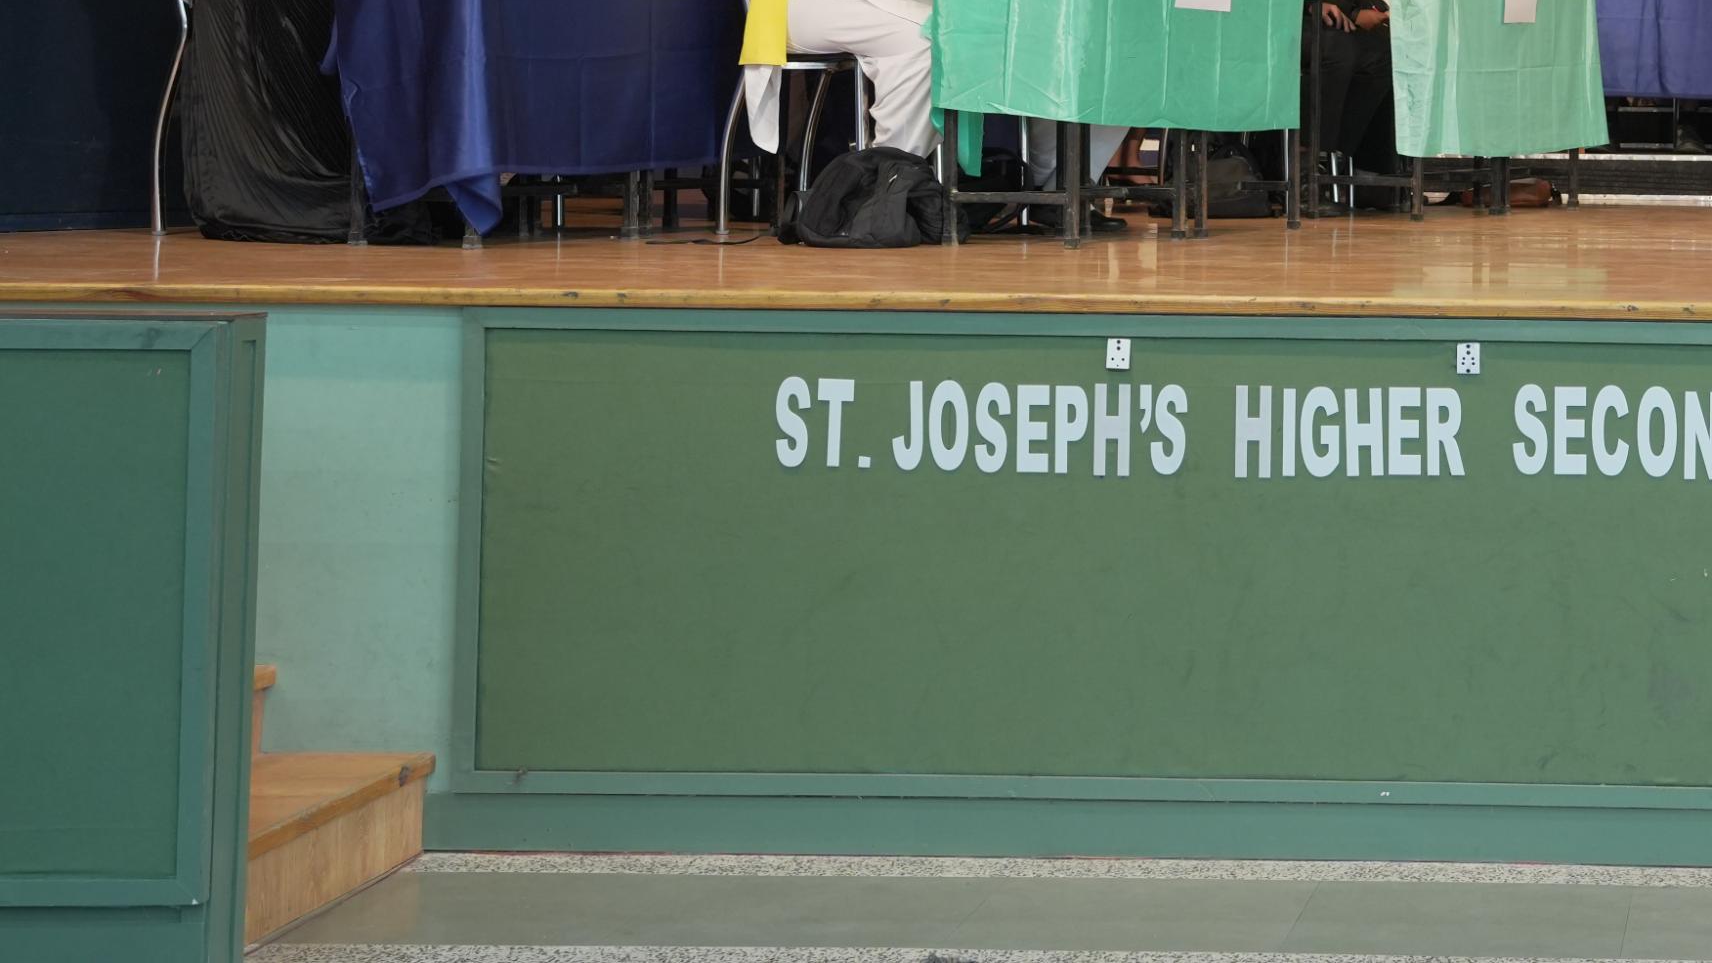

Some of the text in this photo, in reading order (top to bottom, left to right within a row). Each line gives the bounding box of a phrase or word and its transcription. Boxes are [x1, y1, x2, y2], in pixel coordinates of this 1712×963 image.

[775, 376, 871, 468] ST.
[892, 380, 1188, 476] JOSEPH'S
[1234, 384, 1480, 478] HIGHER
